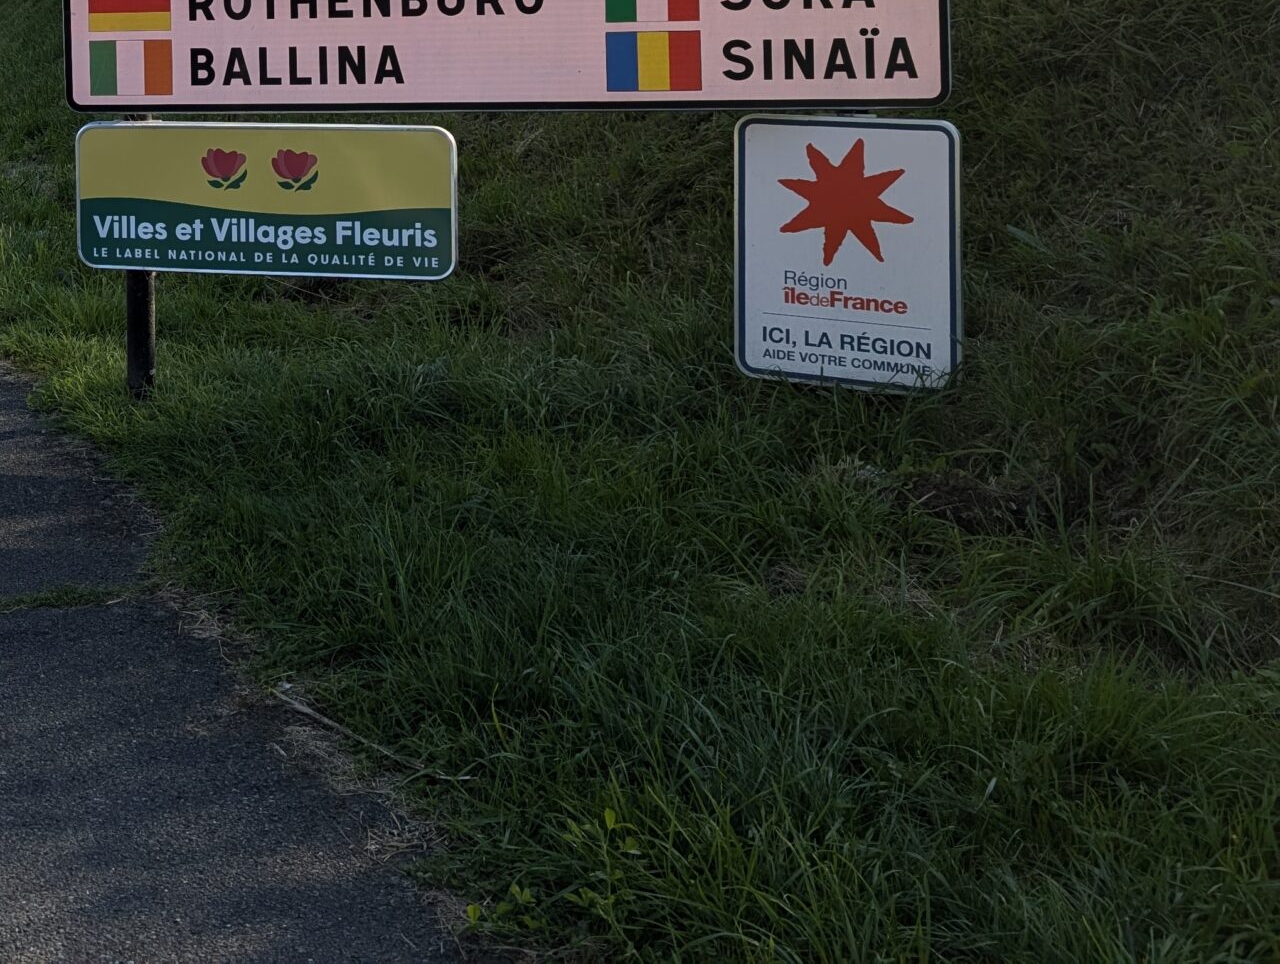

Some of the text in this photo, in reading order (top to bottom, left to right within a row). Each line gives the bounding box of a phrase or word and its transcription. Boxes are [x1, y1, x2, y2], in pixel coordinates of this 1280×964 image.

[190, 27, 918, 86] BALLINA SINAÏA
[93, 215, 438, 250] Villes et Villages Fleuris
[93, 247, 439, 268] LE LABEL NATIONAL DE LA QUALITÉ DE VIE
[784, 270, 848, 291] Région
[762, 326, 932, 360] ICI, LA RÉGION
[762, 348, 931, 377] AIDE VOTRE COMMUNE
